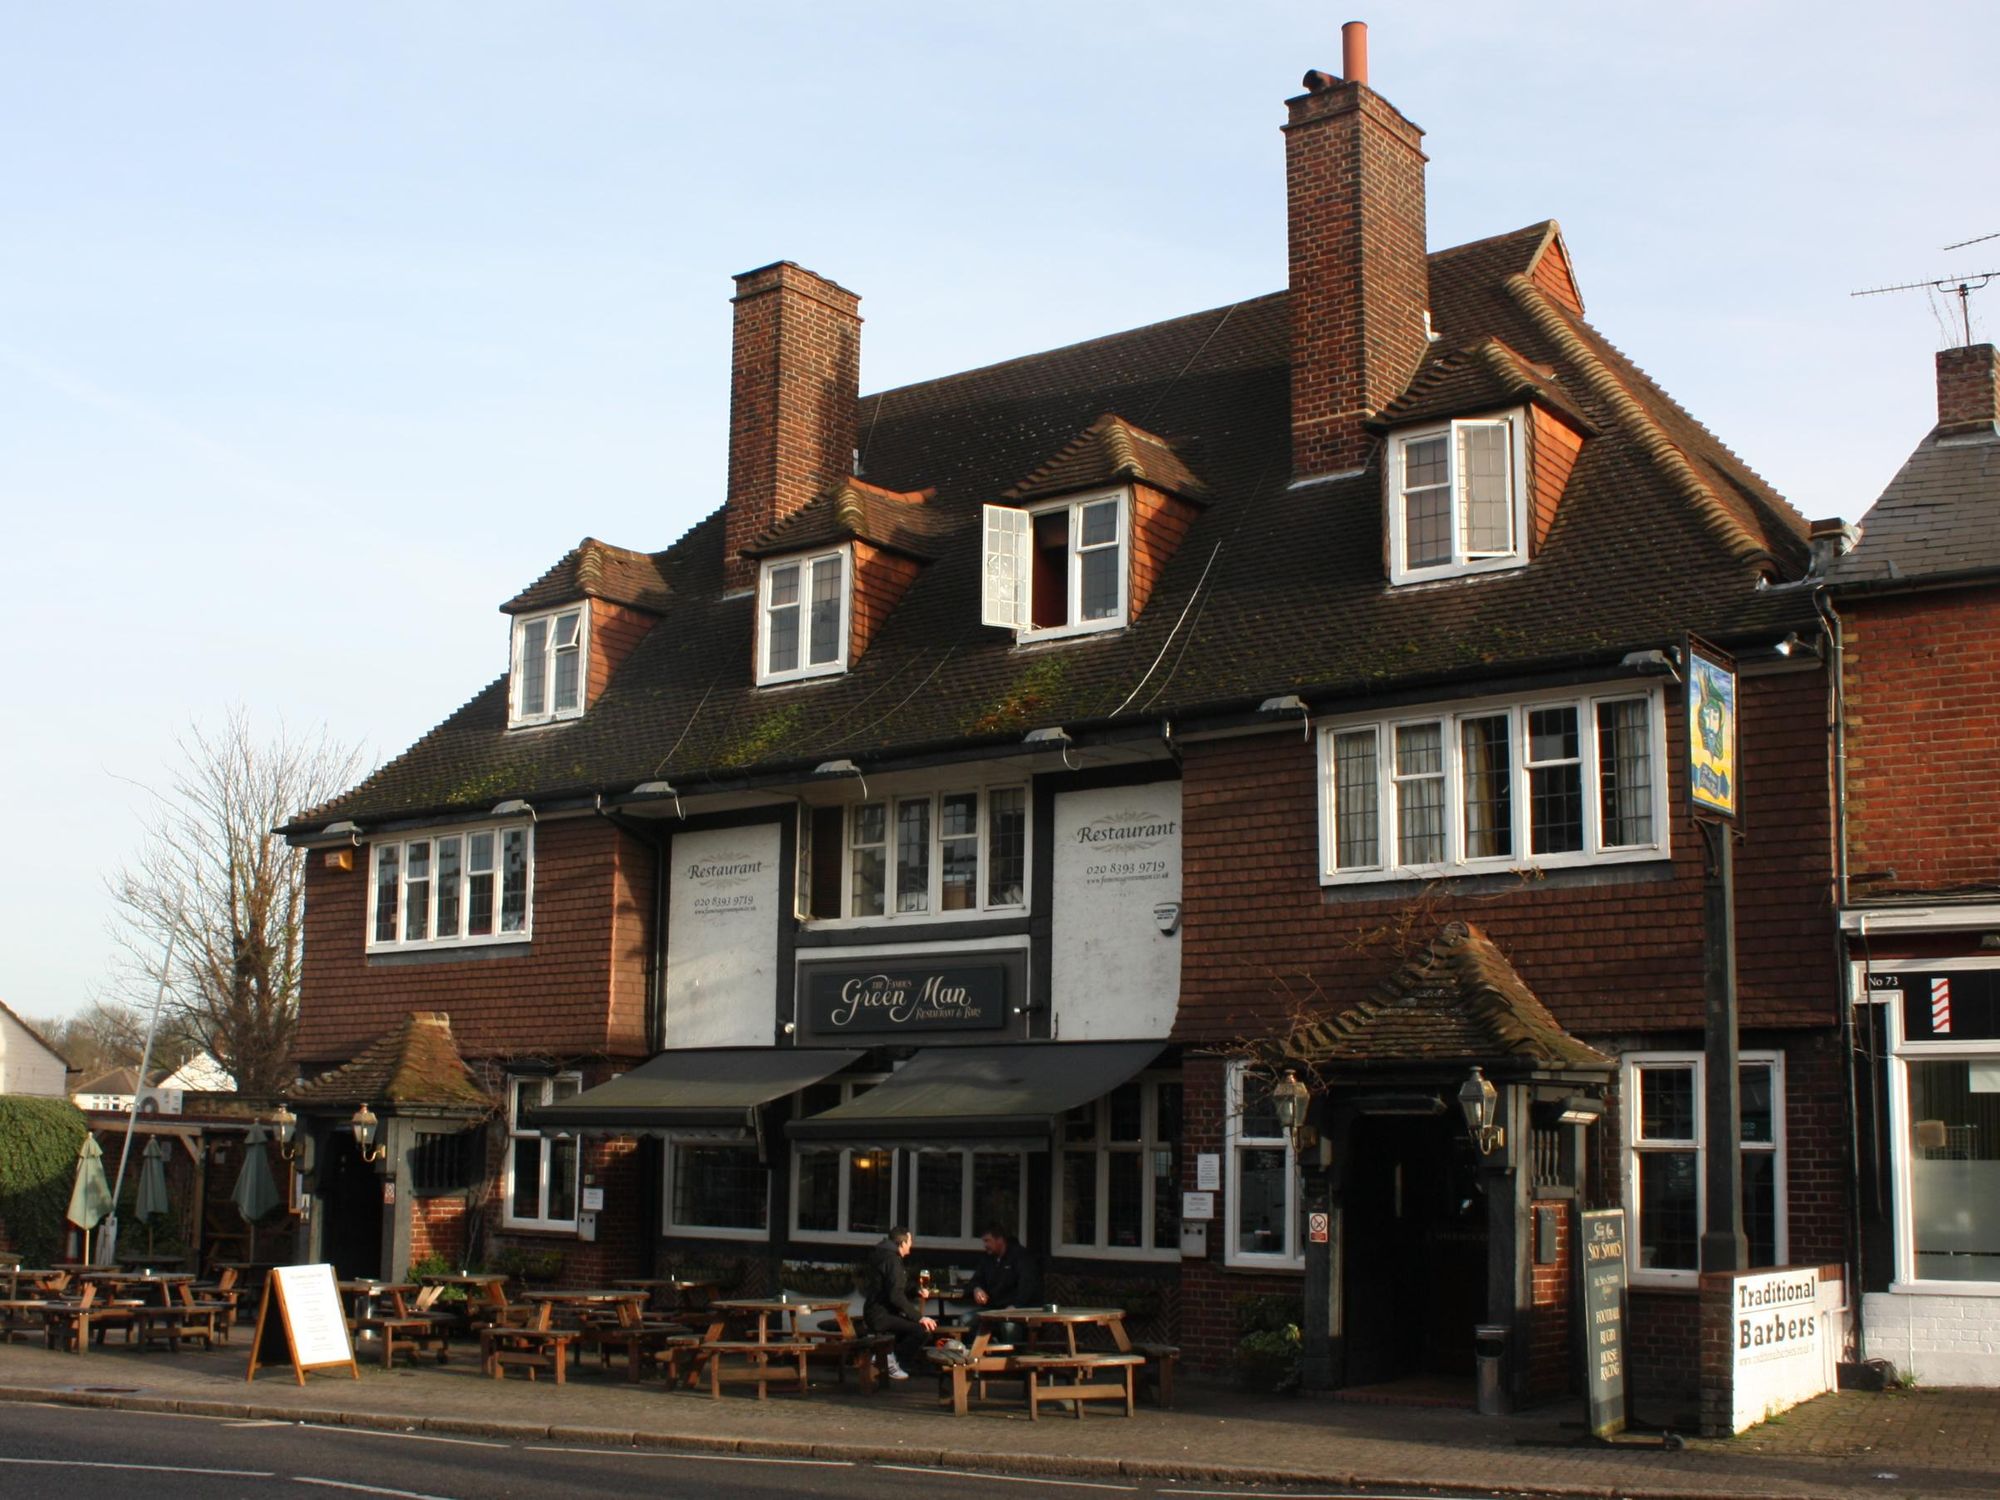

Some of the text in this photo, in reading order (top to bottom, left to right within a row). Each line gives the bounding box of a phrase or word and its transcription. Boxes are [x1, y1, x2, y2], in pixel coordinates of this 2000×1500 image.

[1077, 821, 1176, 844] Restaurant
[688, 861, 762, 879] Restaurant
[1086, 861, 1165, 875] 020 8393 9719
[694, 898, 710, 907] 020
[734, 895, 754, 905] 9719
[1886, 976, 1899, 986] 73
[831, 975, 971, 1025] Green Man
[1739, 1276, 1815, 1308] Traditional
[1740, 1314, 1815, 1349] Barbers
